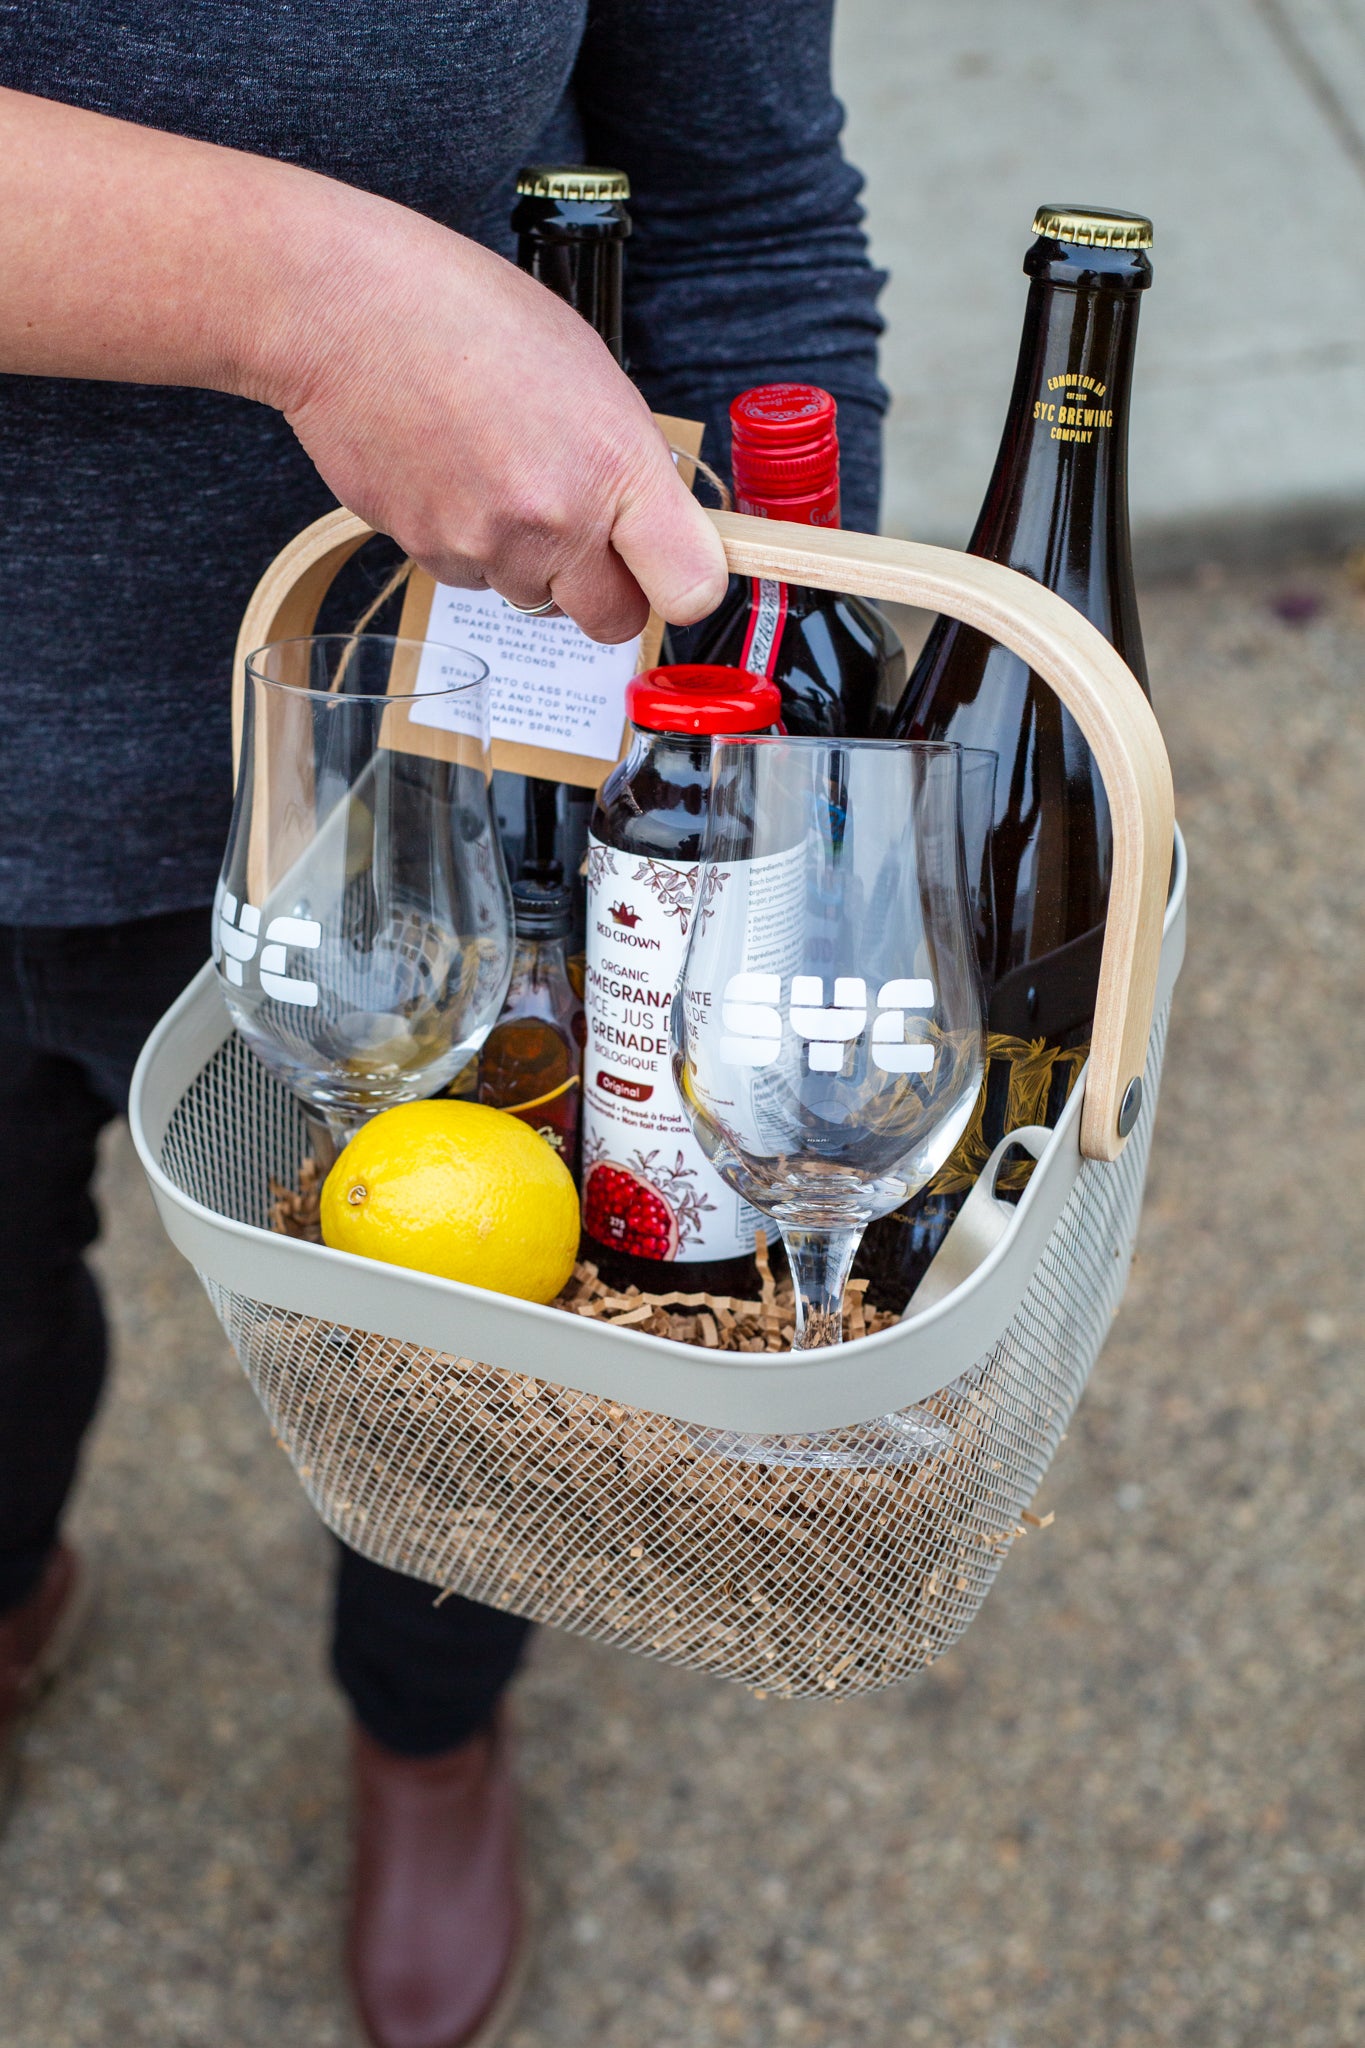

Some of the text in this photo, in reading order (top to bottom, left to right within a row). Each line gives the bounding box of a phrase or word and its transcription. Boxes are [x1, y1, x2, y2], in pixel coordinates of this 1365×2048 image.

[1047, 374, 1107, 397] EDMONTON AB
[1033, 401, 1113, 427] SYC BREWING
[1050, 426, 1093, 443] COMPANY
[448, 601, 473, 613] ADD
[477, 607, 499, 619] ALL
[503, 612, 581, 635] INGREDIENTS
[453, 615, 501, 631] SHAKER
[531, 630, 556, 643] FILL
[561, 637, 593, 649] WITH
[596, 644, 616, 655] ICE
[468, 632, 595, 664] AND SHAKE FOR FIVE
[490, 676, 518, 688] INTO
[522, 681, 561, 696] GLASS
[566, 689, 607, 705] FILLED
[491, 701, 543, 718] GARNISH
[547, 713, 579, 725] WITH
[583, 720, 591, 728] A
[508, 692, 533, 703] AND
[538, 697, 561, 708] TOP
[565, 703, 597, 716] WITH
[613, 930, 661, 951] CROWN
[601, 958, 650, 983] ORGANIC
[621, 1008, 654, 1030] JUS
[719, 972, 936, 1074] SYC
[591, 1016, 668, 1056] GRENADE
[594, 1041, 659, 1072] BIOLOGIQUE
[602, 1076, 640, 1099] Original
[621, 1105, 649, 1119] Pressé
[650, 1112, 658, 1121] à
[659, 1113, 682, 1123] froid
[621, 1116, 638, 1127] Non
[639, 1120, 654, 1130] fait
[656, 1124, 668, 1132] de
